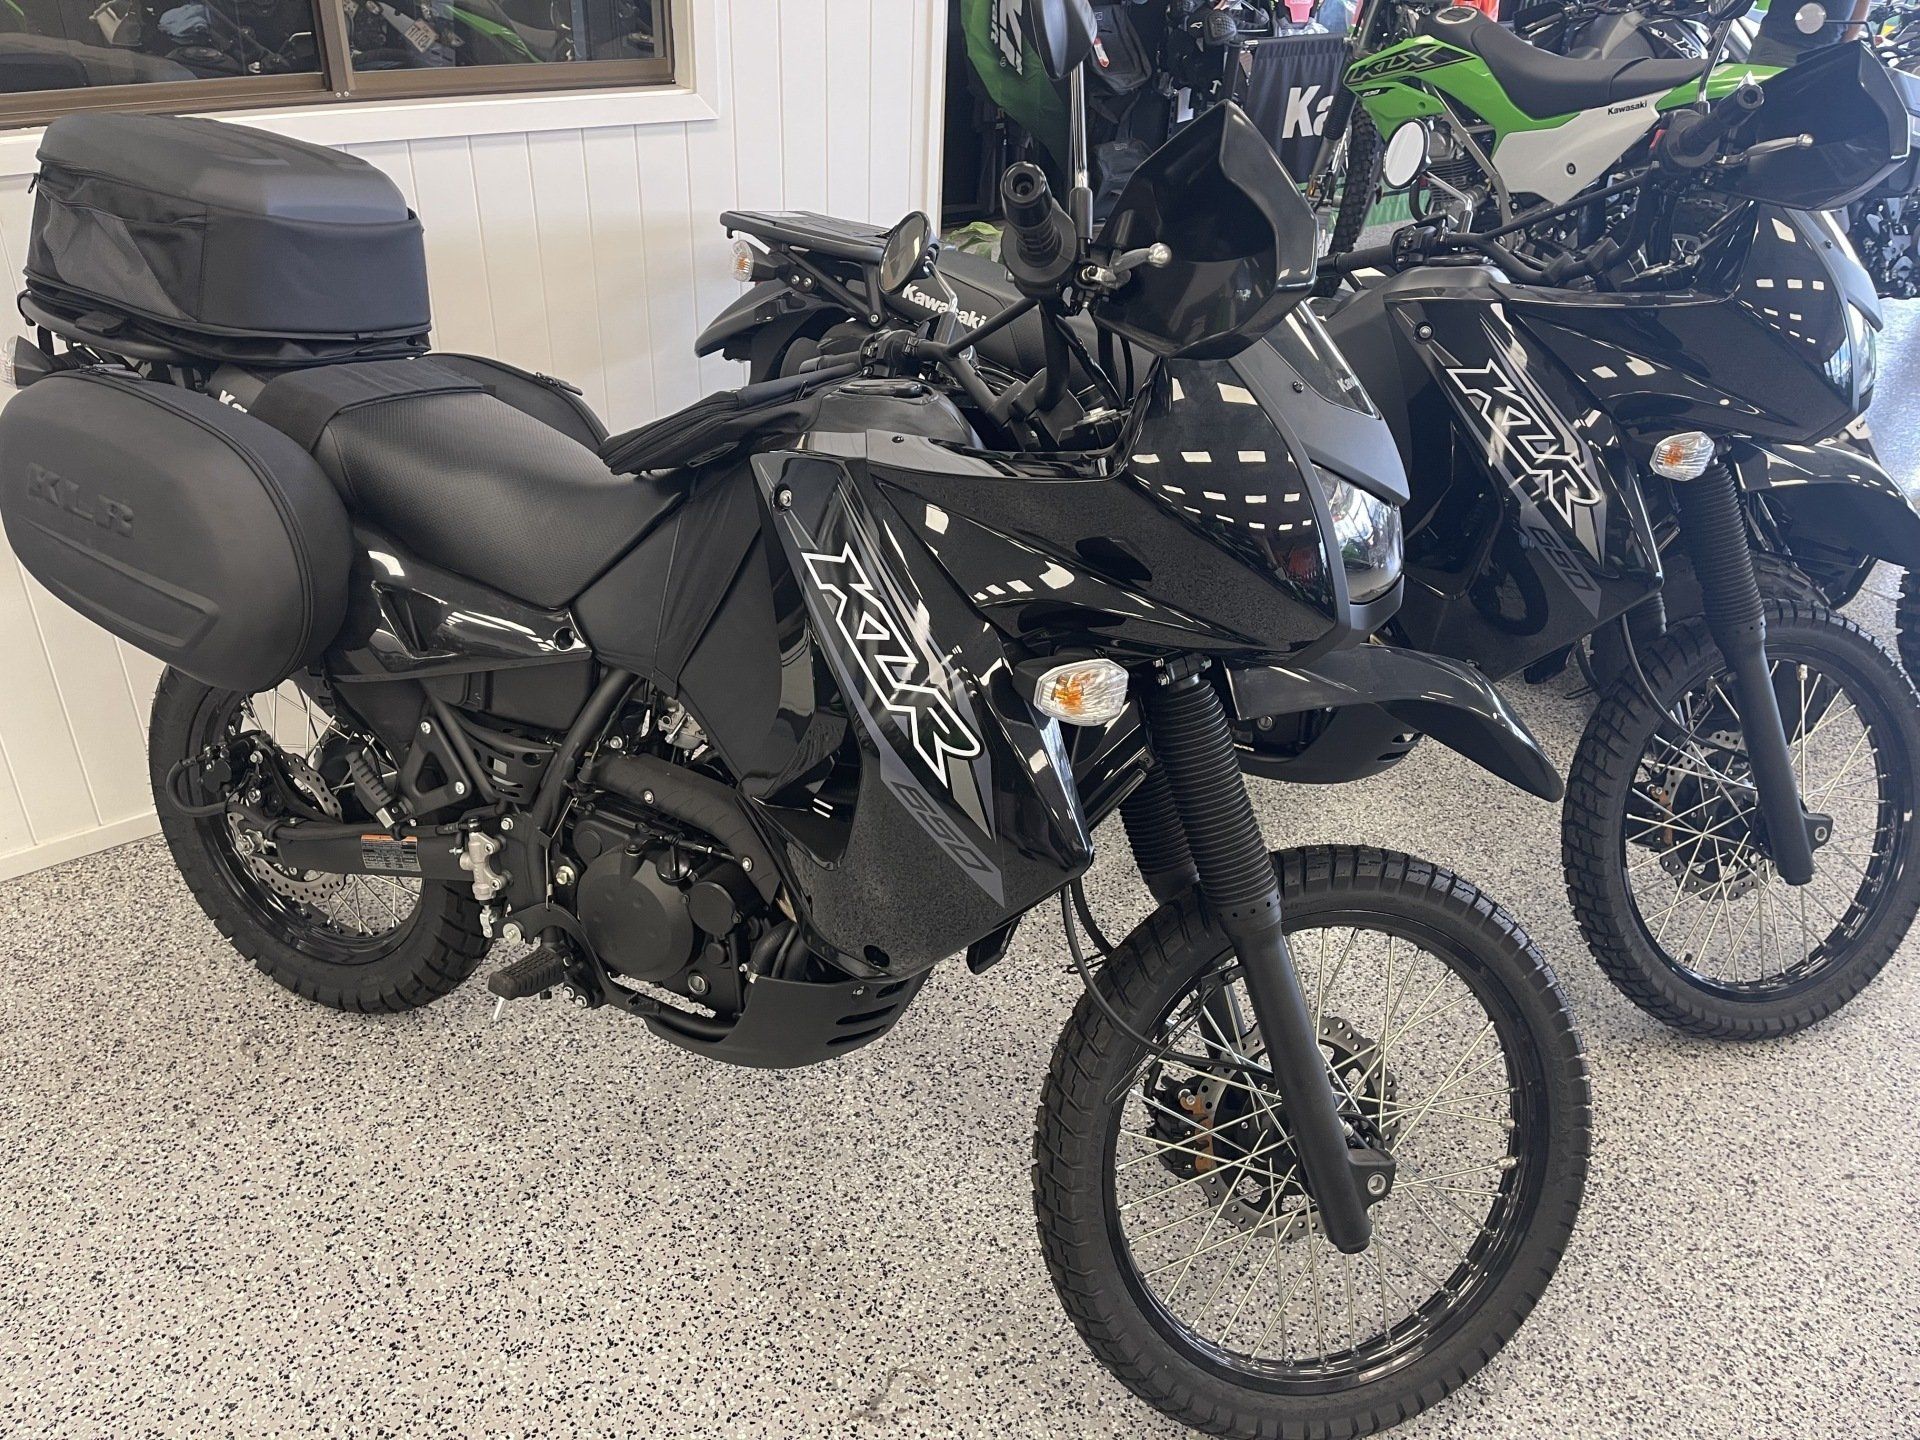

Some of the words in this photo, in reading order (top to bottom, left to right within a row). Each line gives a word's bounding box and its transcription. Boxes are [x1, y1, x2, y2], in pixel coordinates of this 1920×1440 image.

[1350, 45, 1443, 83] KLX
[1607, 100, 1648, 116] Kawasaki
[1446, 357, 1602, 529] KLR
[25, 462, 134, 538] KLR
[1527, 525, 1595, 592] 650
[801, 541, 982, 789] KLR
[890, 780, 994, 874] 650
